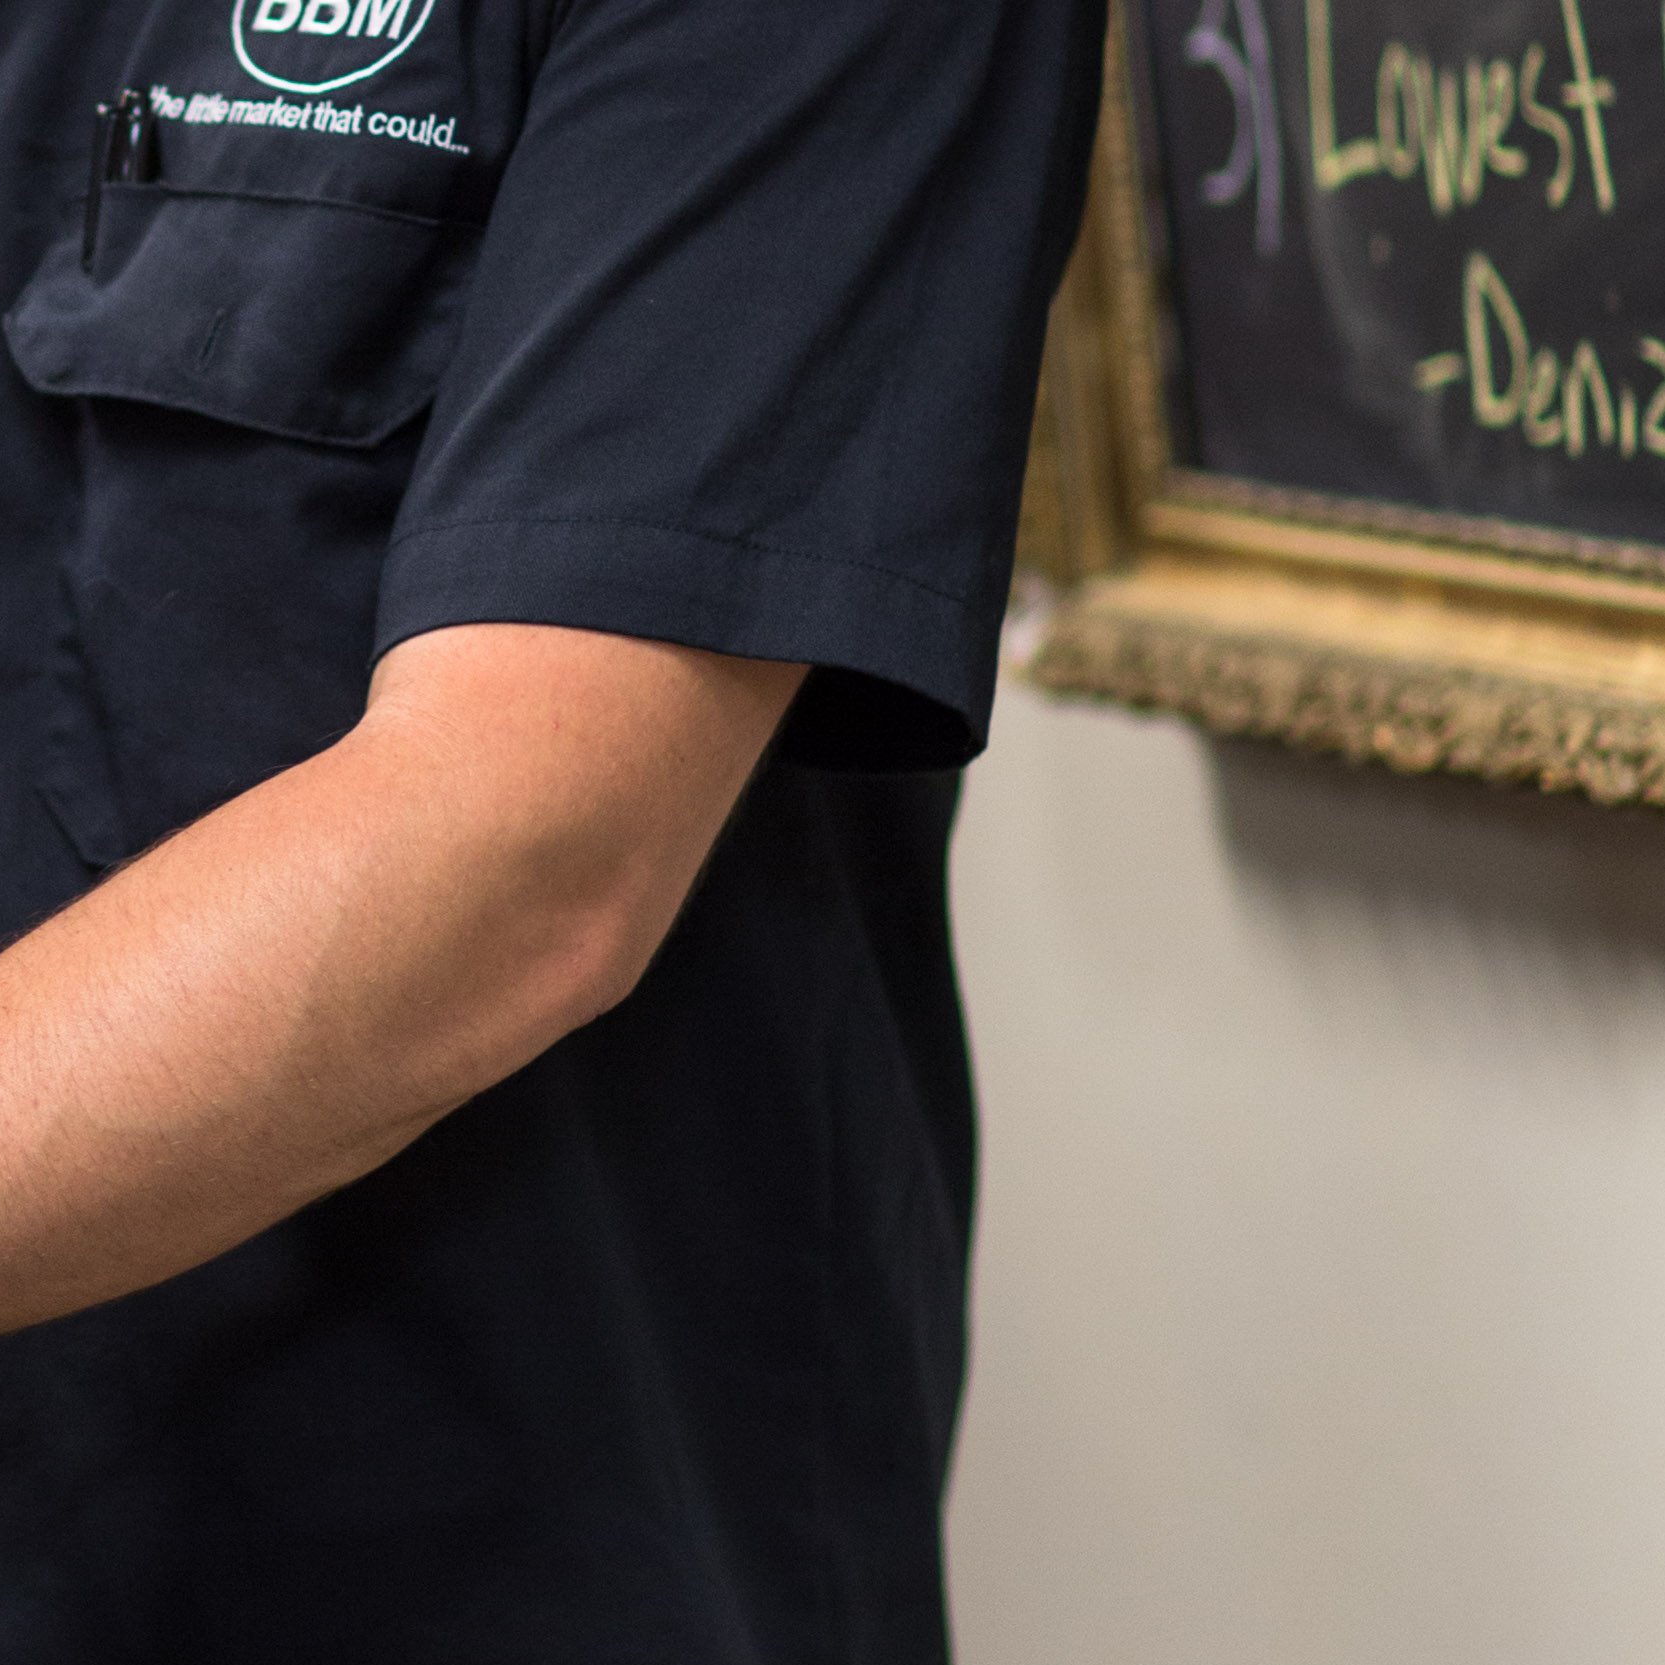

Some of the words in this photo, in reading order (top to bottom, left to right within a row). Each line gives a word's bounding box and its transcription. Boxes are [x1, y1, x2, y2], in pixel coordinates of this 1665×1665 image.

[185, 92, 229, 124] little
[228, 95, 312, 131] market
[312, 100, 364, 135] that
[367, 112, 470, 155] could...
